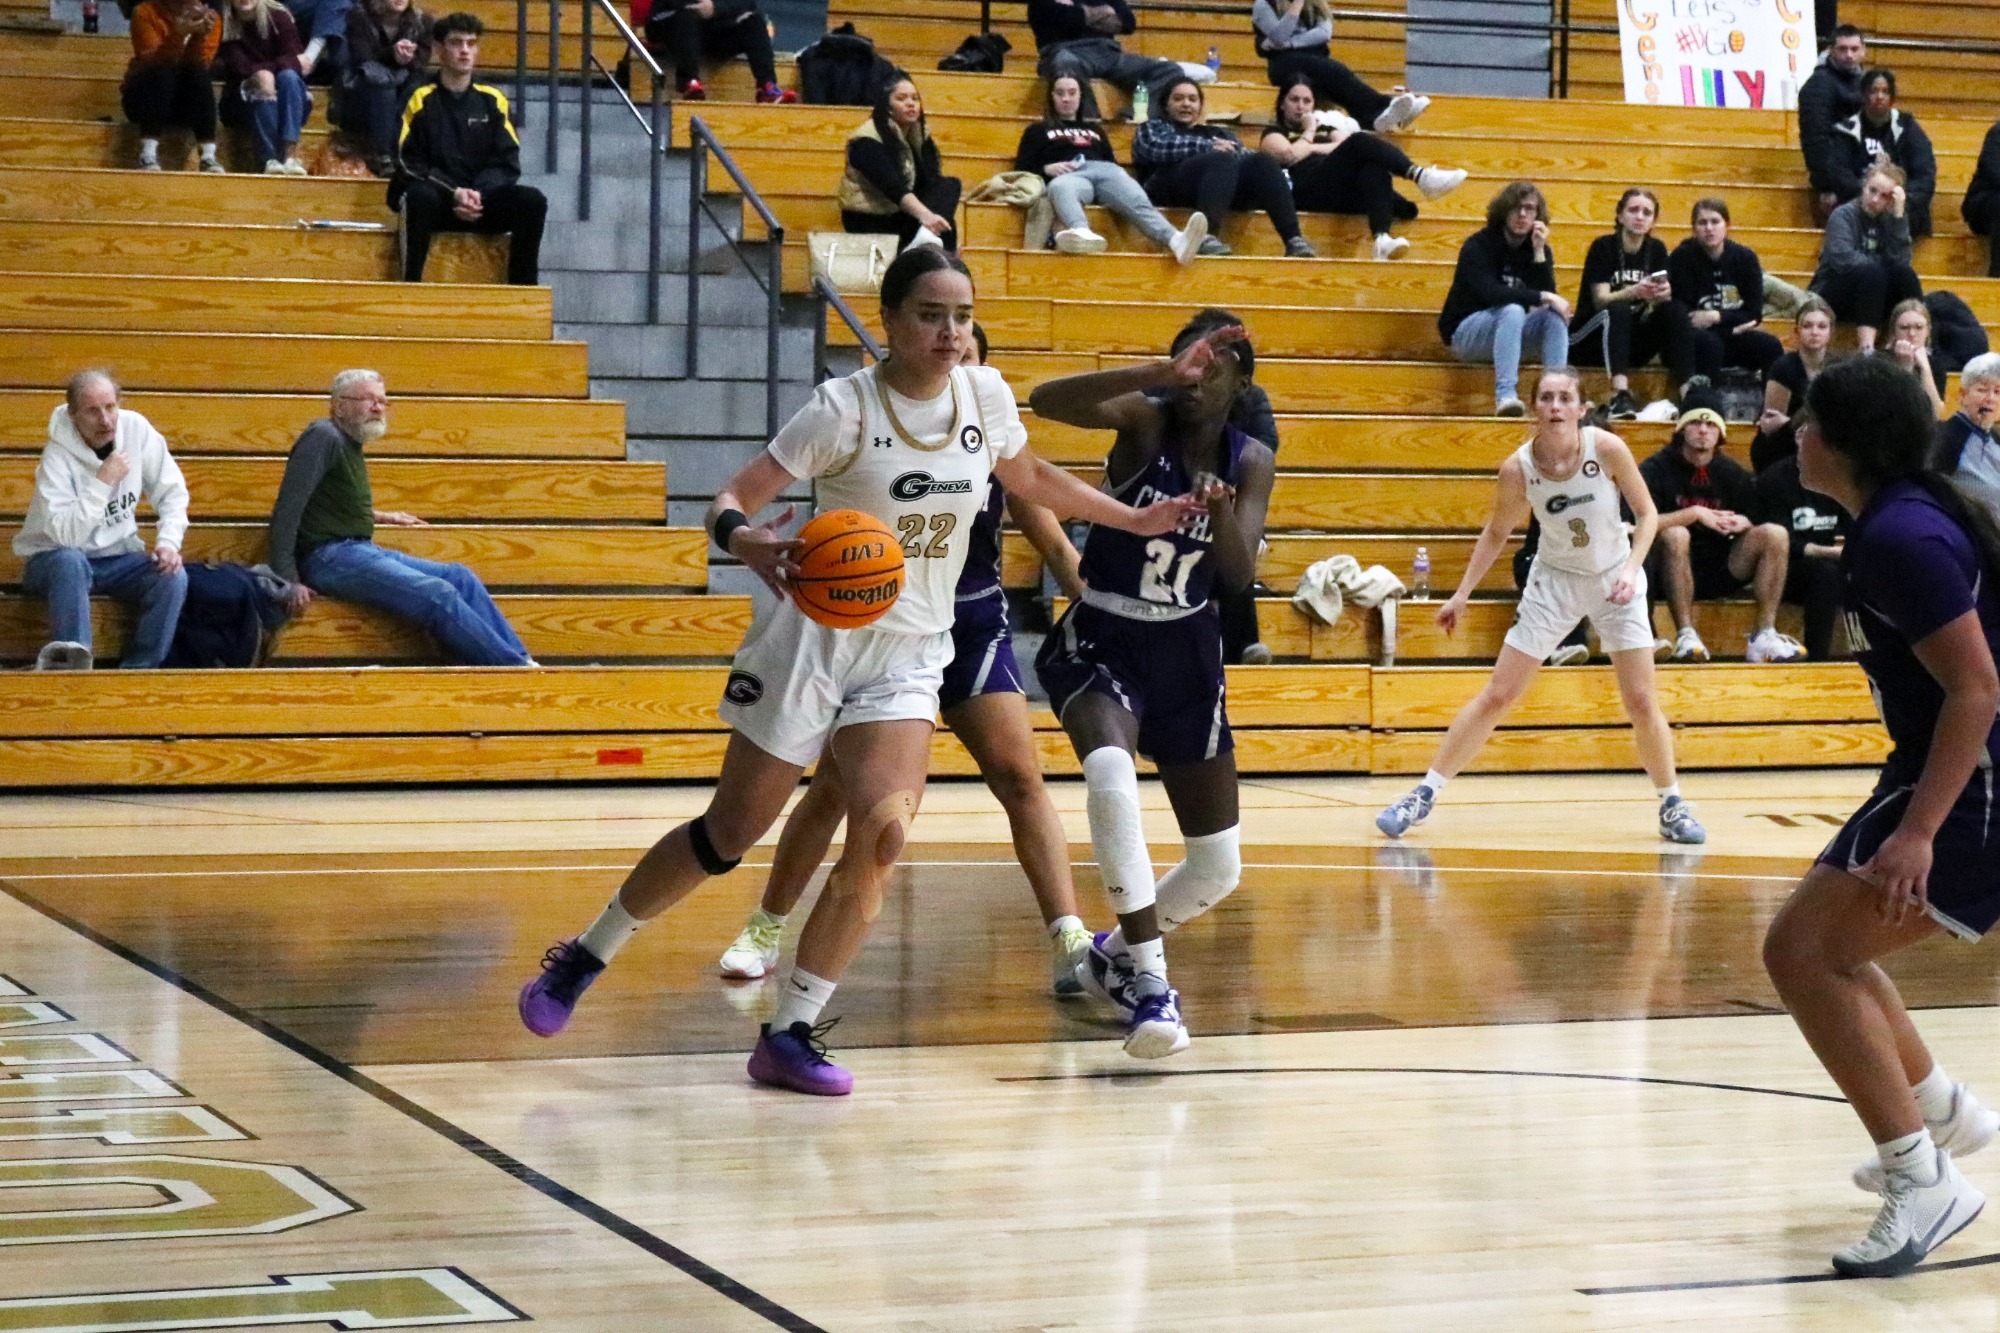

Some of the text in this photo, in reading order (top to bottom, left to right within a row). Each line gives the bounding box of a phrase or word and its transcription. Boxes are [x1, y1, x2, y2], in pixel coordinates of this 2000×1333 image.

[889, 470, 973, 502] GENEVA
[898, 512, 957, 559] 22
[1567, 517, 1591, 548] 3
[1139, 538, 1206, 608] 21
[827, 578, 899, 606] Wilson
